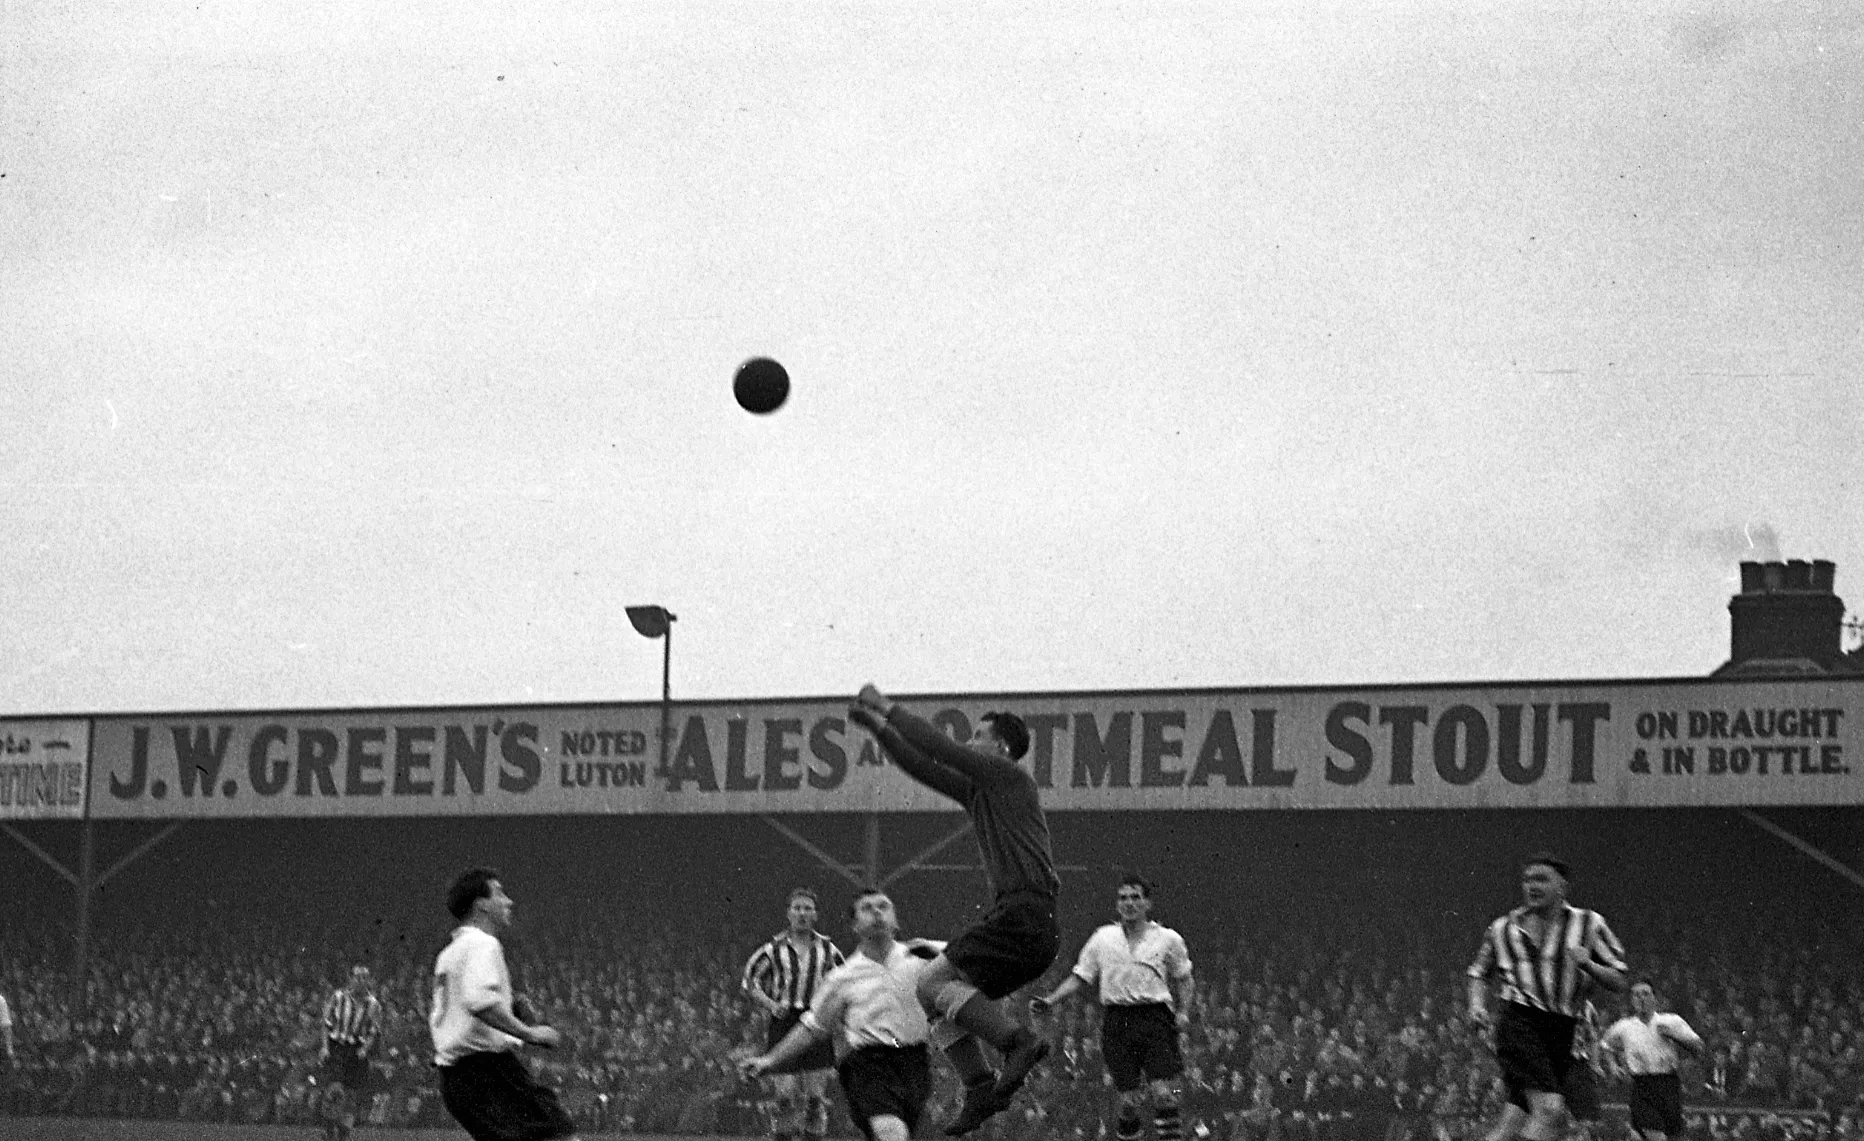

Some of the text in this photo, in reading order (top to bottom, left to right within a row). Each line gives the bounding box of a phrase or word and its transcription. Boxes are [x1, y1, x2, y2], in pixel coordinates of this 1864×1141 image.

[1635, 708, 1845, 739] ON DRAUGHT
[561, 730, 646, 756] NOTED
[666, 702, 1611, 793] ALES TMEAL STOUT
[561, 762, 646, 788] LUTON
[1629, 744, 1850, 775] & IN BOTTLE.
